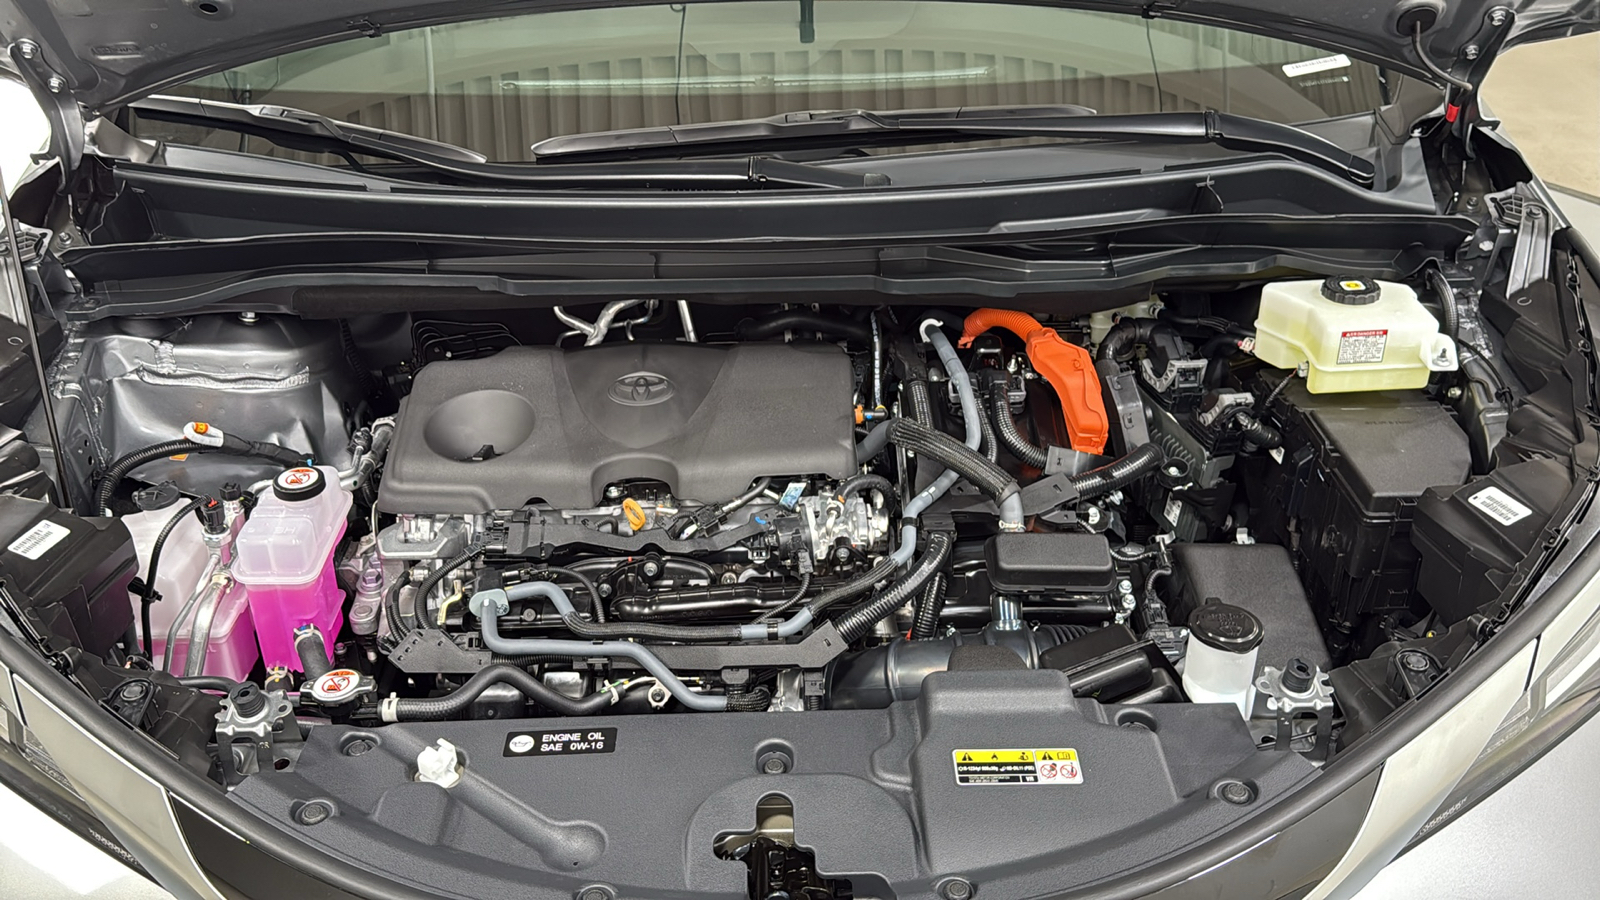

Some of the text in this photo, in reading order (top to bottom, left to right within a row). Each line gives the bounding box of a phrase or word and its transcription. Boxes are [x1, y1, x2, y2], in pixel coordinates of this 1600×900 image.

[542, 731, 605, 742] ENGINE OIL
[540, 741, 604, 751] SAE 0W-16
